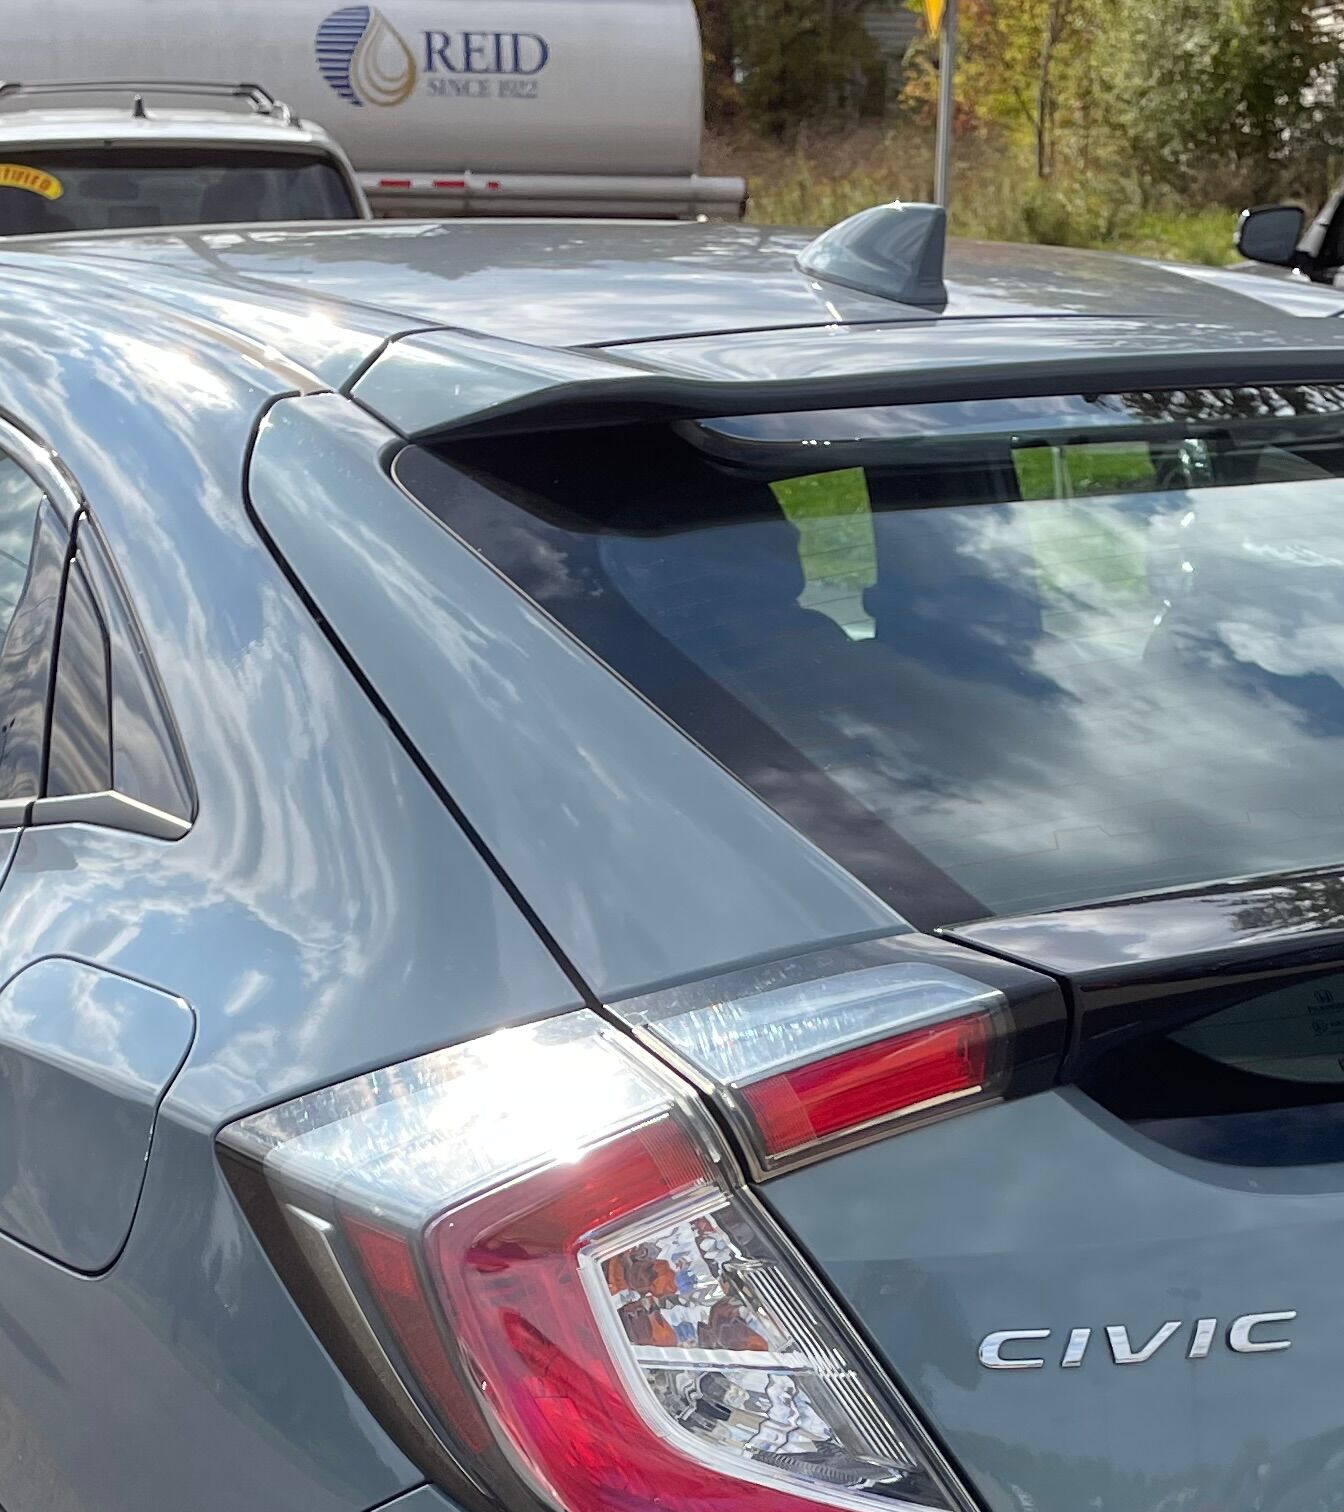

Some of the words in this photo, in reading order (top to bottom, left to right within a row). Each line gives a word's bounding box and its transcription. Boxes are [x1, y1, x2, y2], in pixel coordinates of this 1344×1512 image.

[422, 31, 549, 75] REID
[426, 78, 491, 97] SINCE
[977, 1310, 1297, 1369] CIVIC
